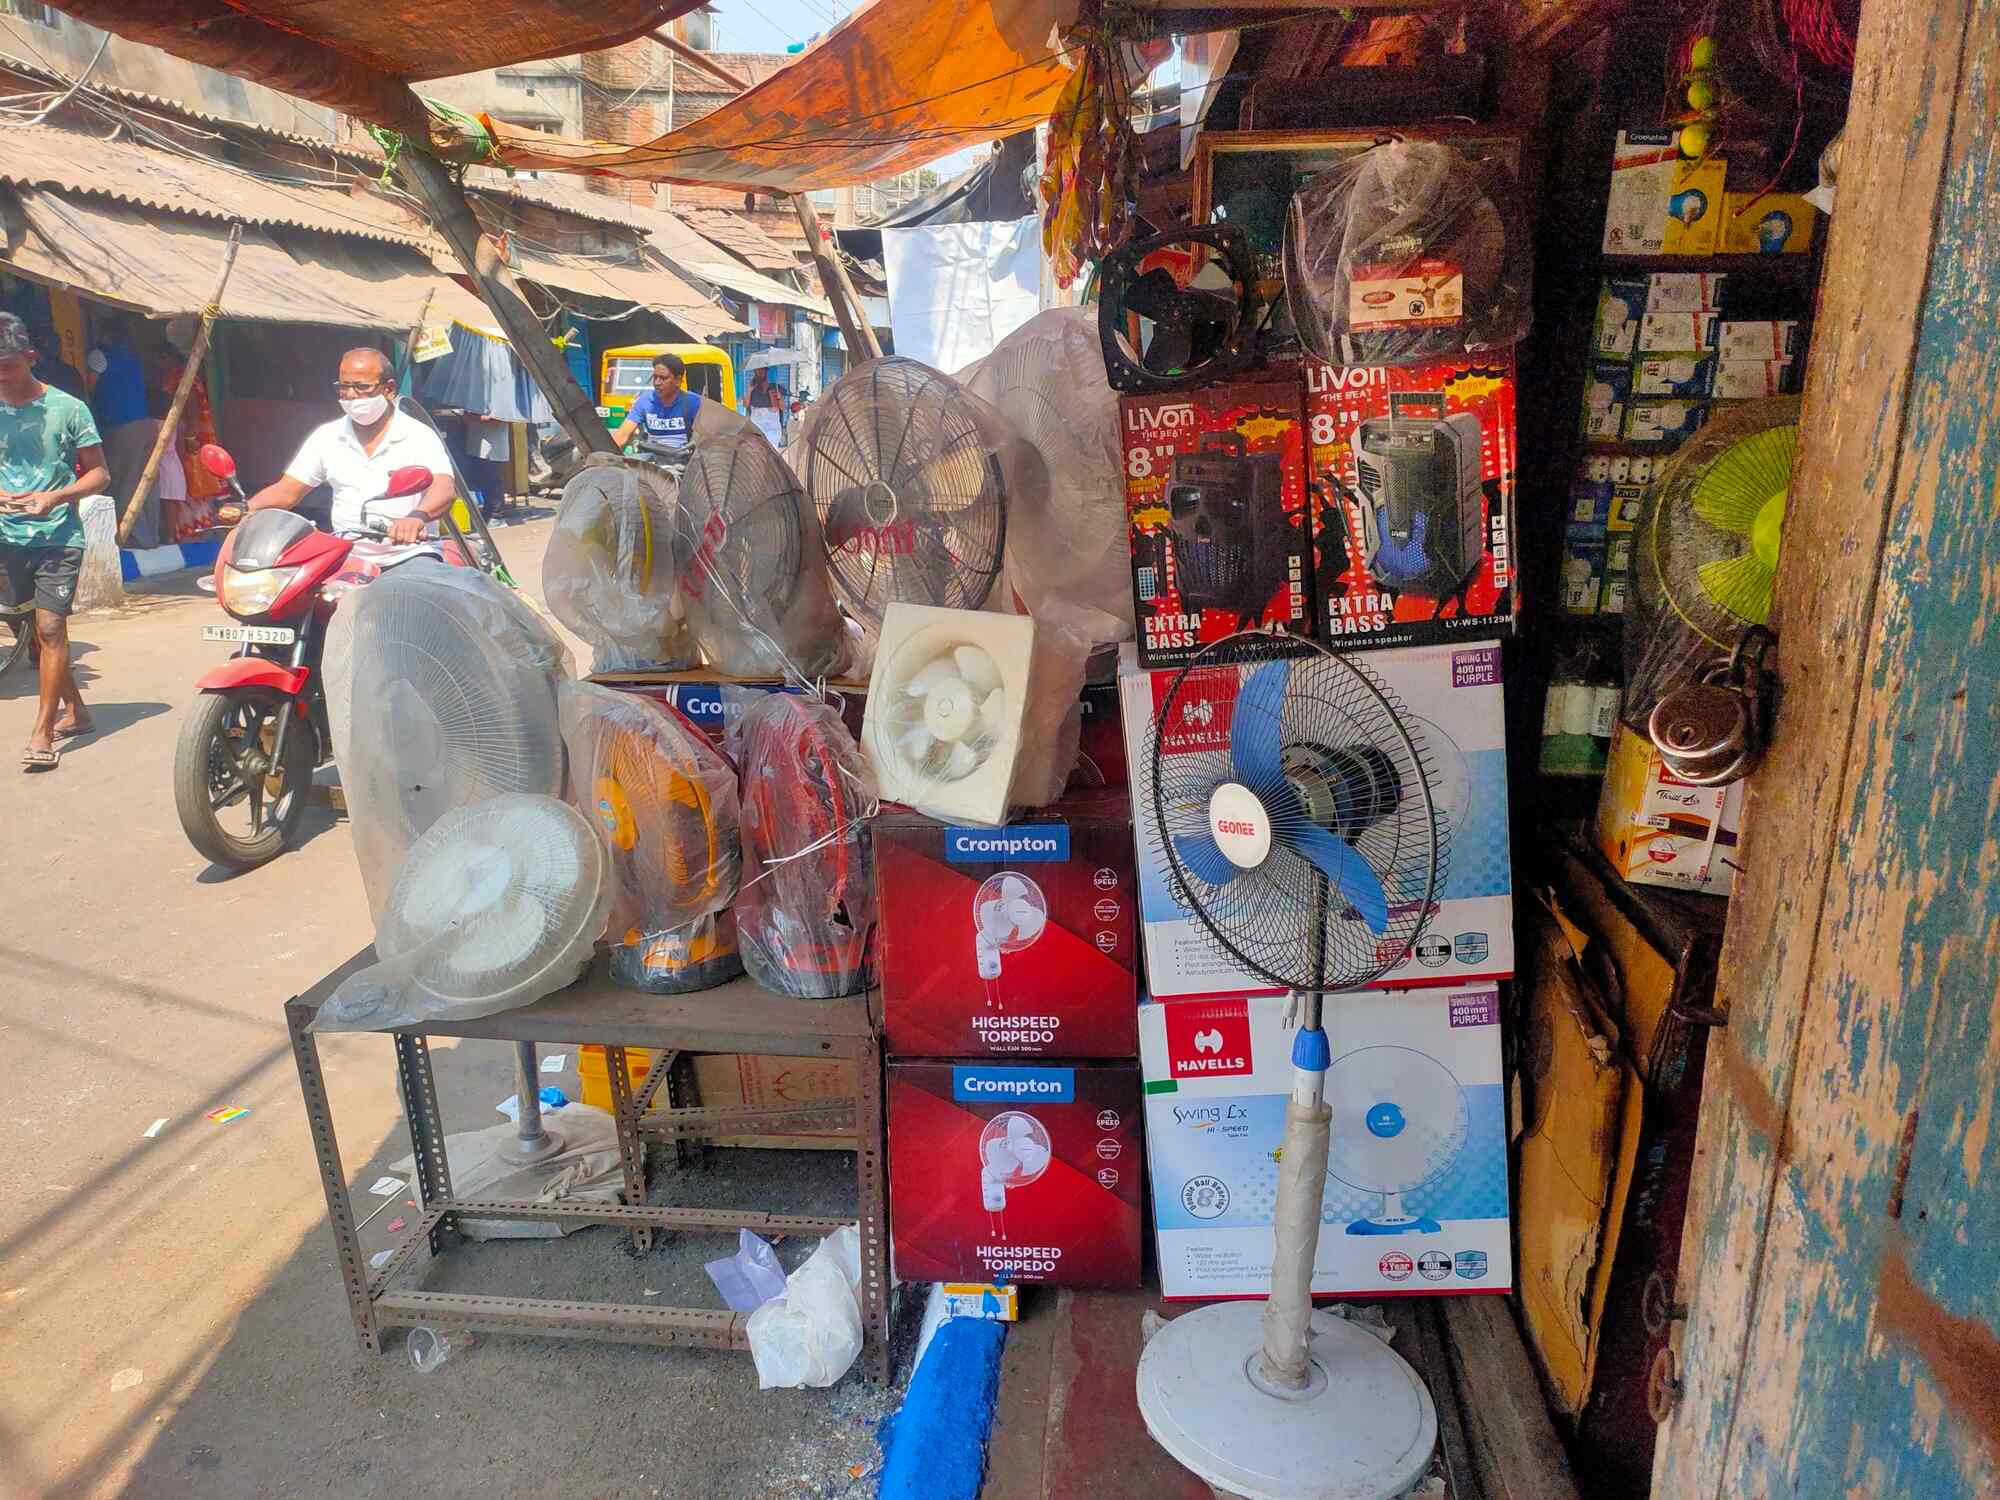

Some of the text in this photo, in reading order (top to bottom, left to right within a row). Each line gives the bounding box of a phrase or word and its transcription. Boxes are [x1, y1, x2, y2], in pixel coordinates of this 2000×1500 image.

[1322, 389, 1373, 402] THE BEAT
[1328, 593, 1394, 616] EXTRA
[1145, 613, 1201, 633] EXTRA
[1330, 614, 1386, 635] BASS
[1146, 632, 1195, 650] BASS
[1332, 634, 1414, 648] Wireless speaker
[1456, 673, 1493, 685] PURPLE
[956, 836, 1057, 856] Crompton
[971, 1016, 1060, 1030] HIGHSPEED
[1452, 1014, 1488, 1025] PURPLE
[978, 1030, 1055, 1043] TORPEDO
[1176, 1057, 1245, 1072] HAVELLS
[963, 1077, 1062, 1096] Crompton
[1172, 1105, 1220, 1125] Swing
[976, 1246, 1062, 1259] HIGHSPEED
[983, 1259, 1056, 1271] TORPEDO
[1390, 1262, 1410, 1272] Year
